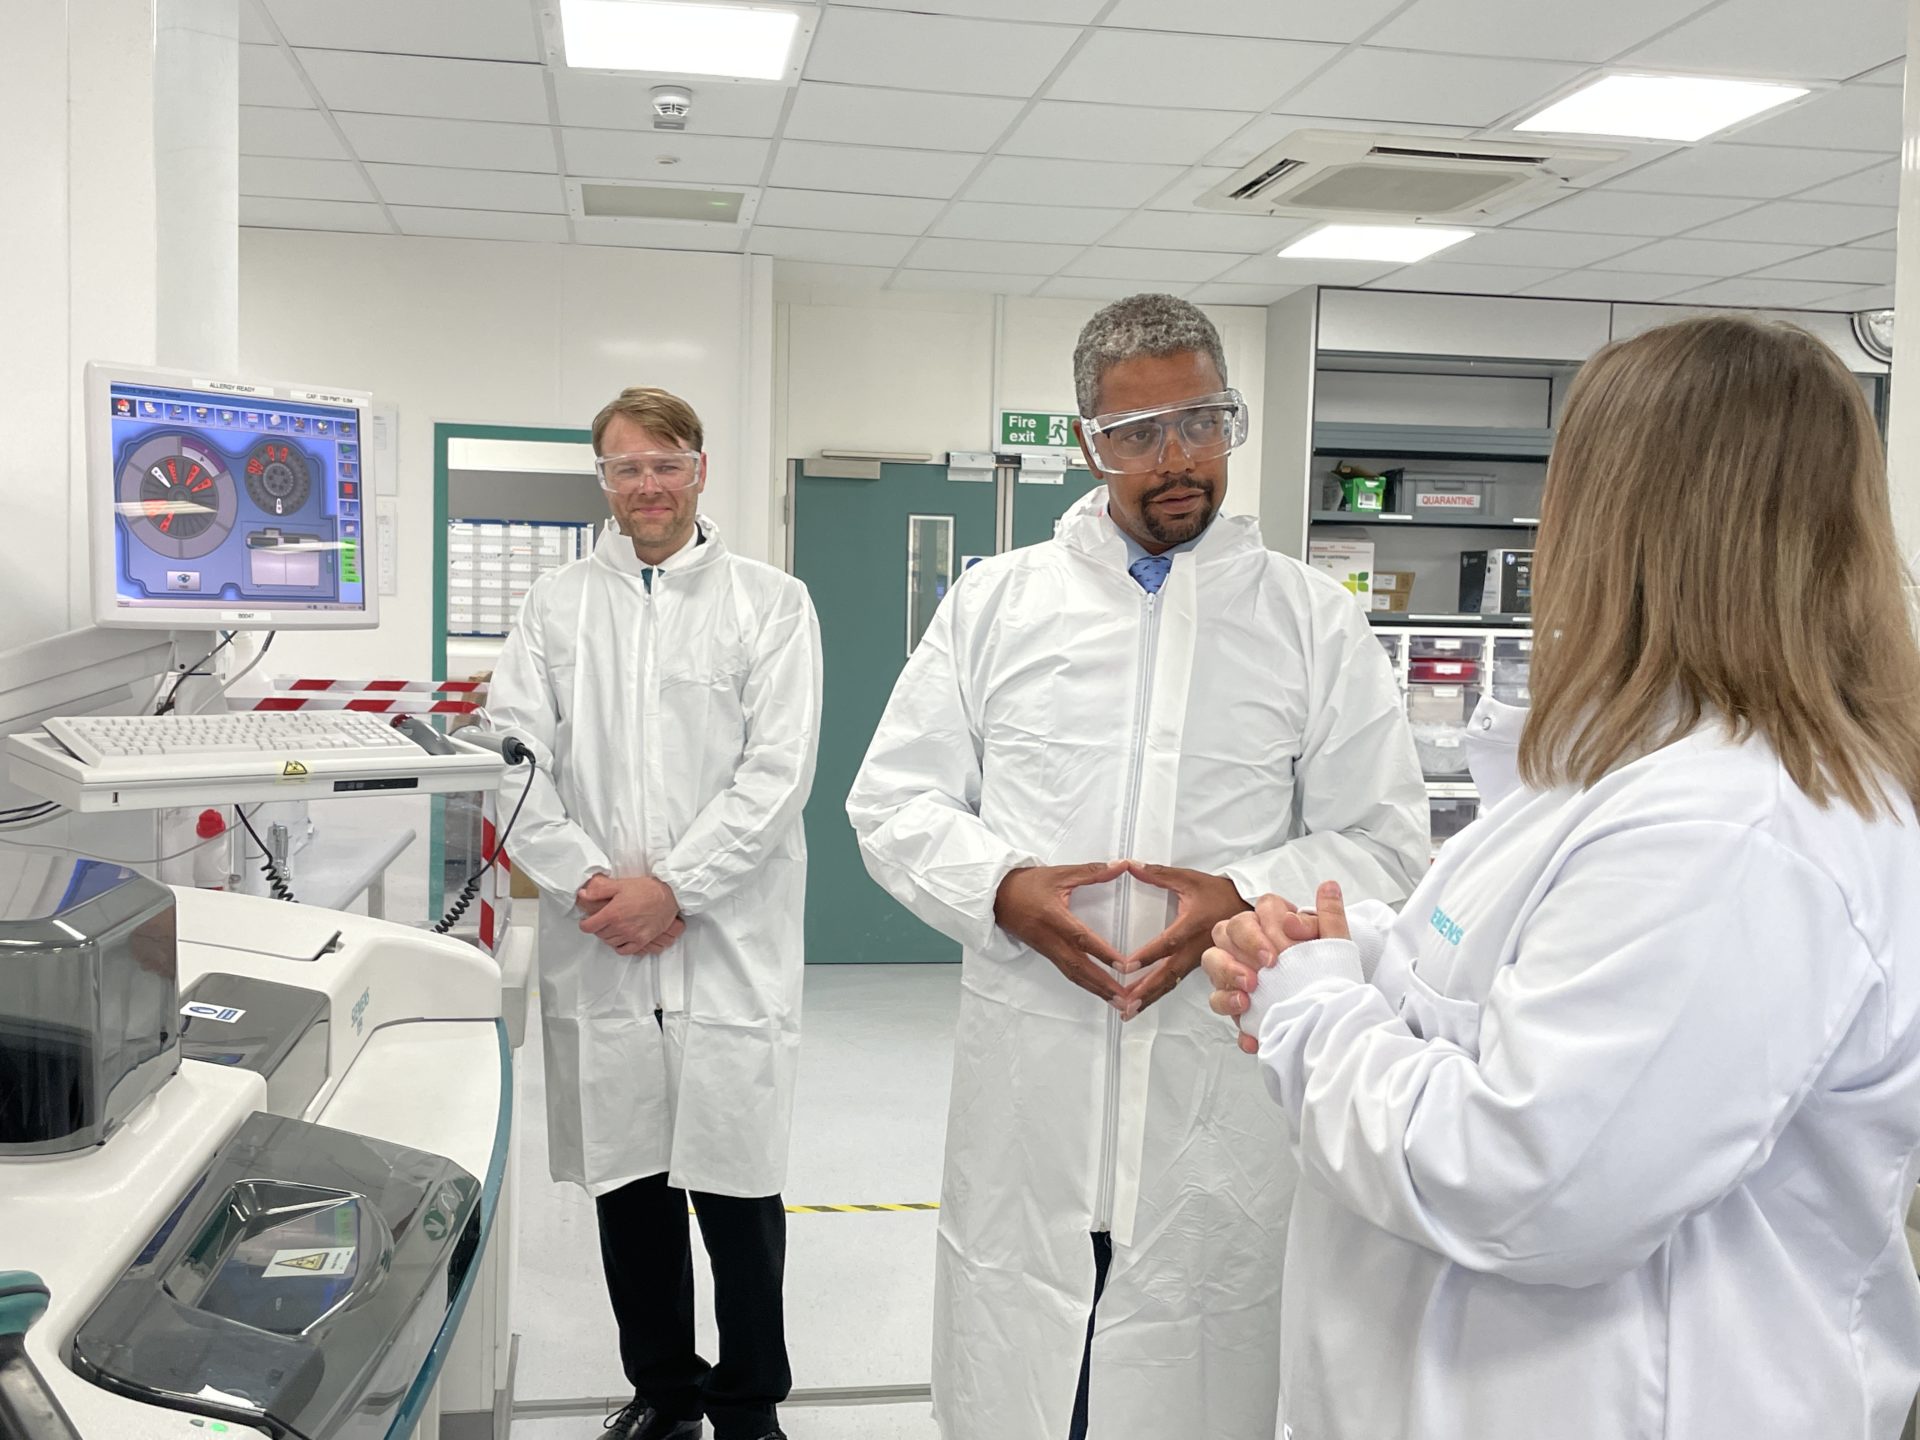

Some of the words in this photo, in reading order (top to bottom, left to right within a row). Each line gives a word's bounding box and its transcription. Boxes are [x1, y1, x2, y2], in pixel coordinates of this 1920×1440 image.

[209, 382, 235, 390] ALLERGY
[1008, 415, 1037, 428] Fire
[1009, 430, 1035, 443] exit
[1422, 495, 1475, 506] QUARANTINE
[1430, 905, 1465, 946] EMENS
